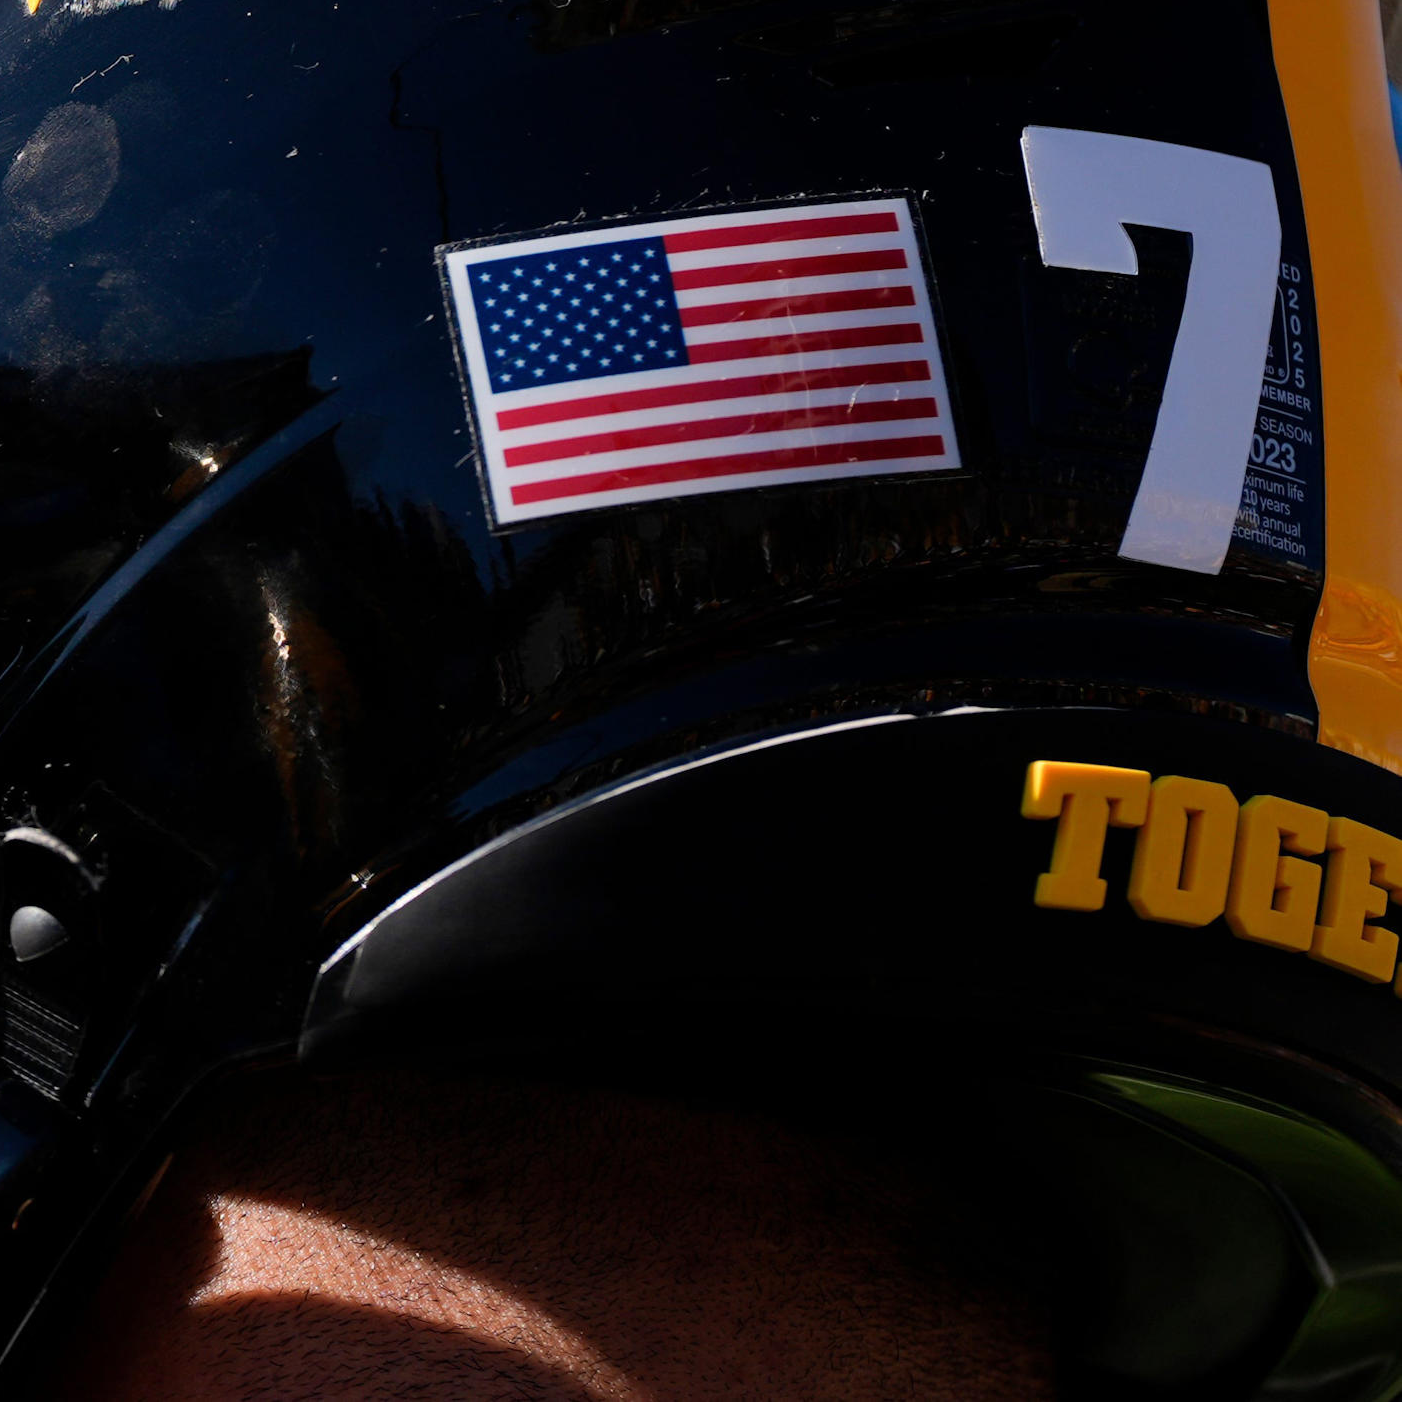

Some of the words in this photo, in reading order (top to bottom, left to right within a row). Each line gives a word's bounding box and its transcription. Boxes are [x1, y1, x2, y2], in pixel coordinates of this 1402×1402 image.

[1020, 125, 1282, 575] 7
[1261, 385, 1311, 412] MEMBER
[1259, 415, 1313, 446] SEASON
[1250, 434, 1297, 473] 023
[1243, 489, 1259, 507] 10
[1260, 495, 1291, 516] years
[1245, 474, 1285, 496] ximum
[1286, 482, 1305, 503] life
[1236, 505, 1261, 527] with
[1262, 515, 1302, 540] annual
[1232, 526, 1306, 557] ecertification
[1020, 759, 1402, 1000] TOGE
